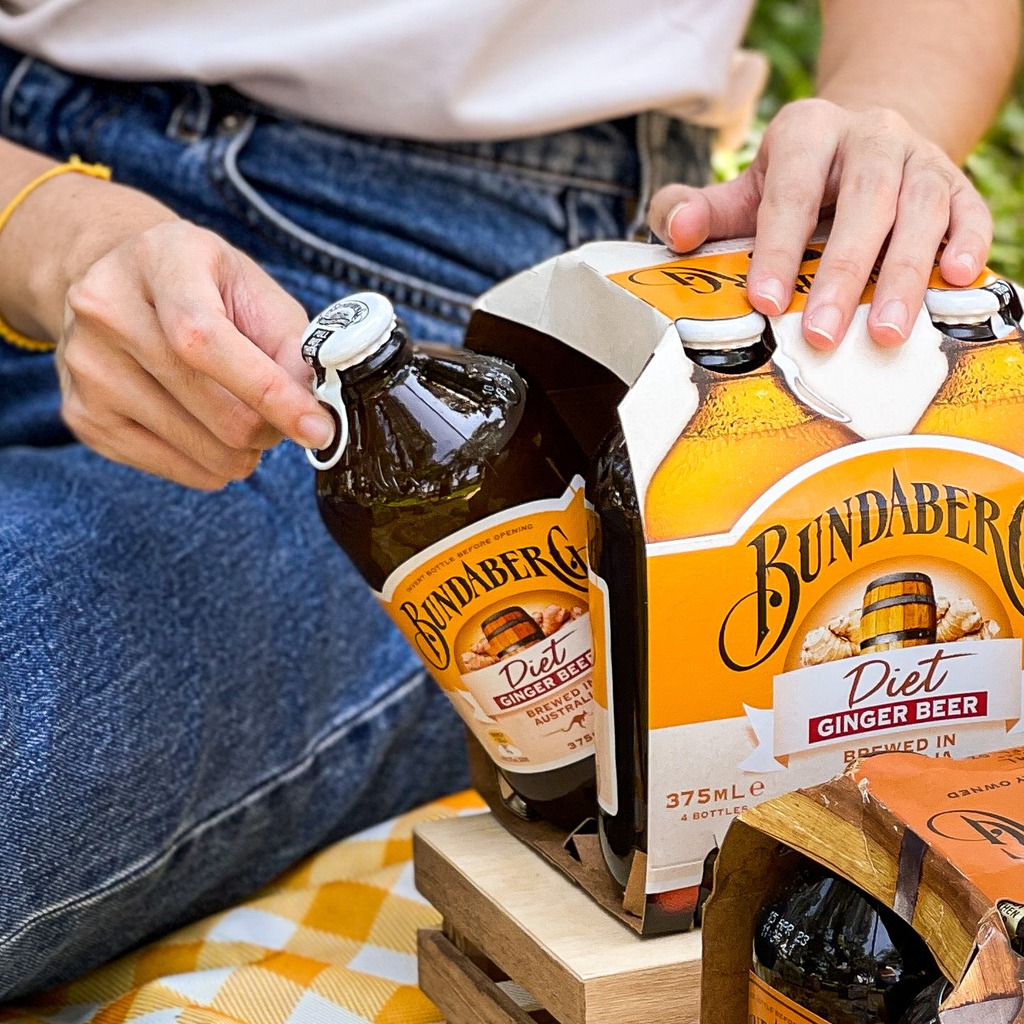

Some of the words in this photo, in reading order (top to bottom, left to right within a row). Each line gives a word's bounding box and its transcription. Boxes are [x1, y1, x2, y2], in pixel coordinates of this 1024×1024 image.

[425, 555, 456, 576] BOTTLE
[457, 537, 492, 559] BEFORE
[493, 523, 534, 541] OPENING
[400, 525, 589, 671] BUNDABERG
[499, 629, 578, 689] Diet
[500, 679, 557, 707] GINGER
[843, 648, 978, 709] Diet
[526, 687, 581, 718] BREWED
[535, 693, 593, 726] AUSTRALI
[817, 705, 912, 737] GINGER
[915, 696, 978, 720] BEER
[567, 733, 595, 750] 375
[936, 734, 956, 748] IN
[946, 779, 1011, 799] OWNED
[692, 805, 749, 820] BOTTLES
